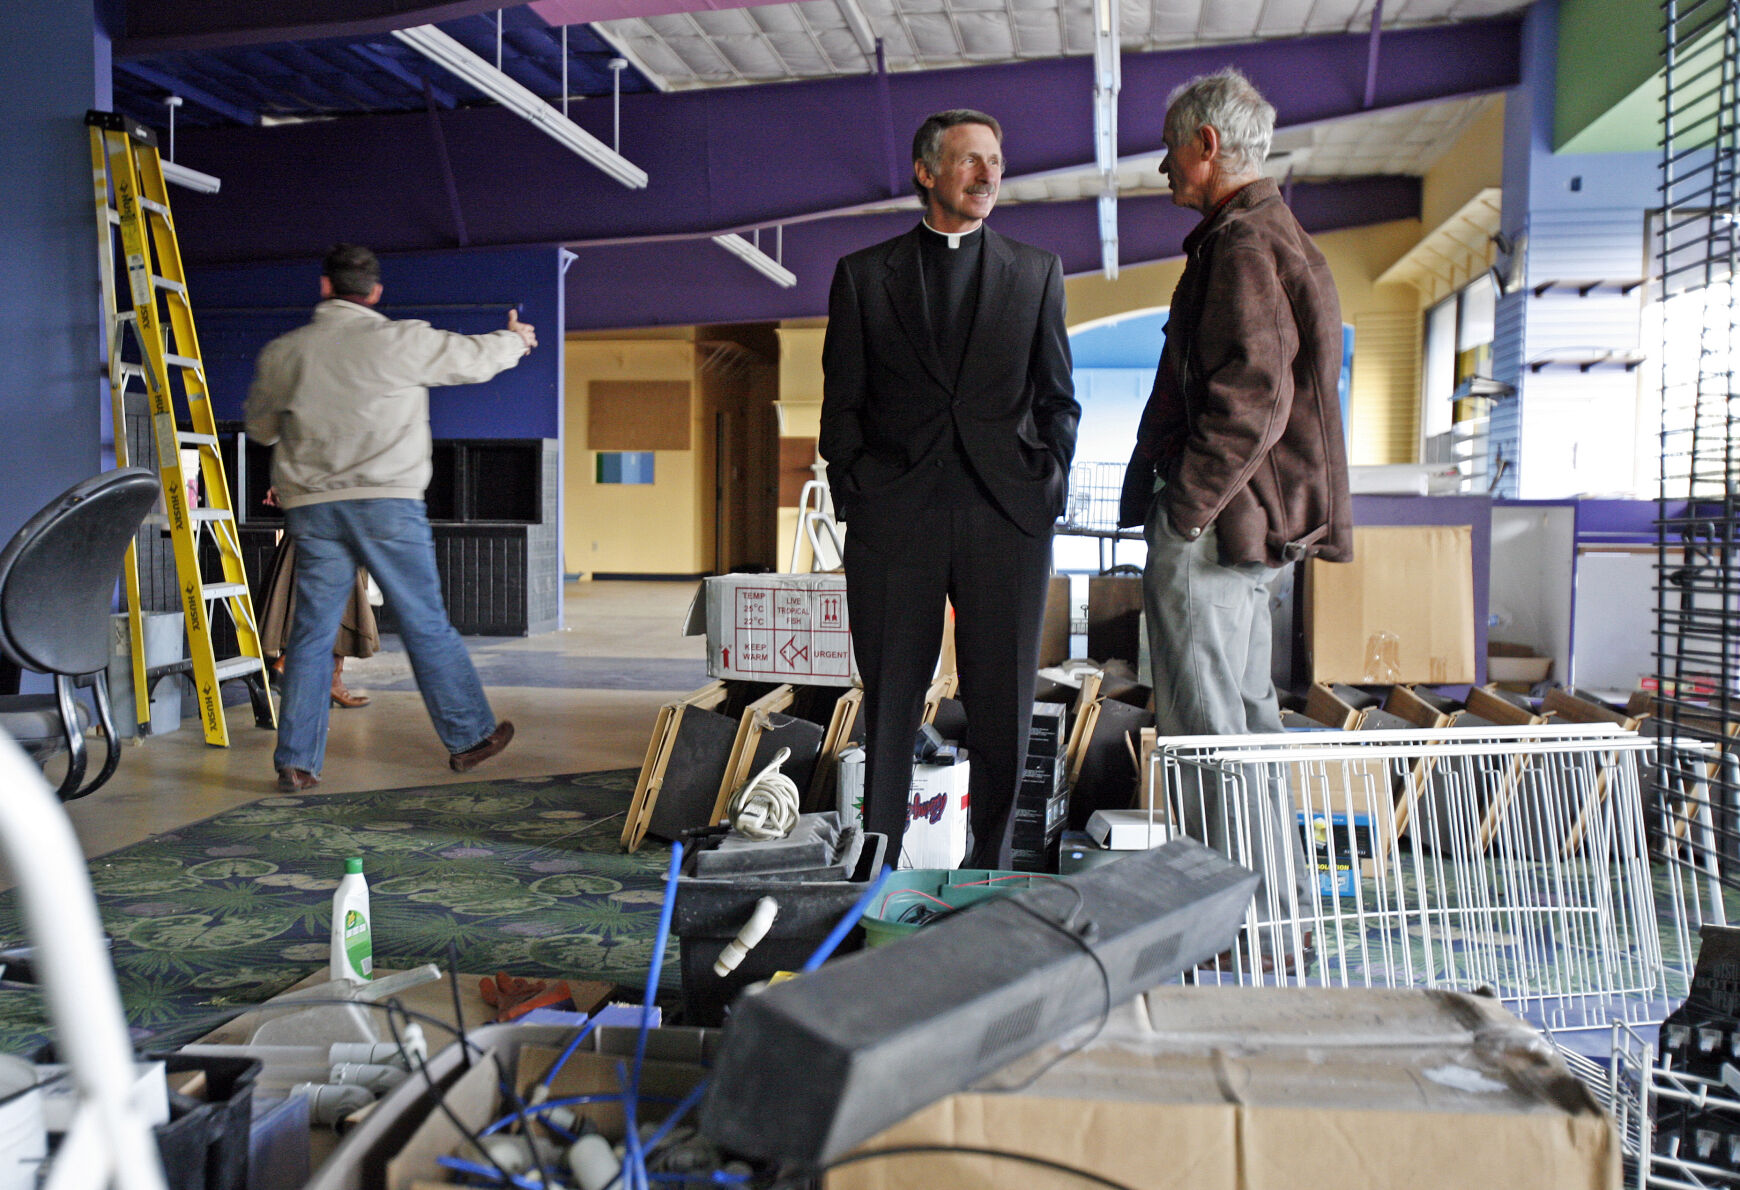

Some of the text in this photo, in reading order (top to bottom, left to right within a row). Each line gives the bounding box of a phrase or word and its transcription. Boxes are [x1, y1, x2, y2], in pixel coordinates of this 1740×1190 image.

[171, 495, 184, 531] HUSKY
[742, 592, 766, 600] TEMP
[786, 597, 801, 606] LIVE
[188, 595, 200, 632] HUSKY
[777, 606, 810, 616] TROPICAL
[786, 617, 802, 625] FISH
[744, 643, 767, 651] KEEP
[743, 653, 769, 661] WARM
[813, 651, 848, 659] URGENT
[204, 696, 218, 735] HUSKY
